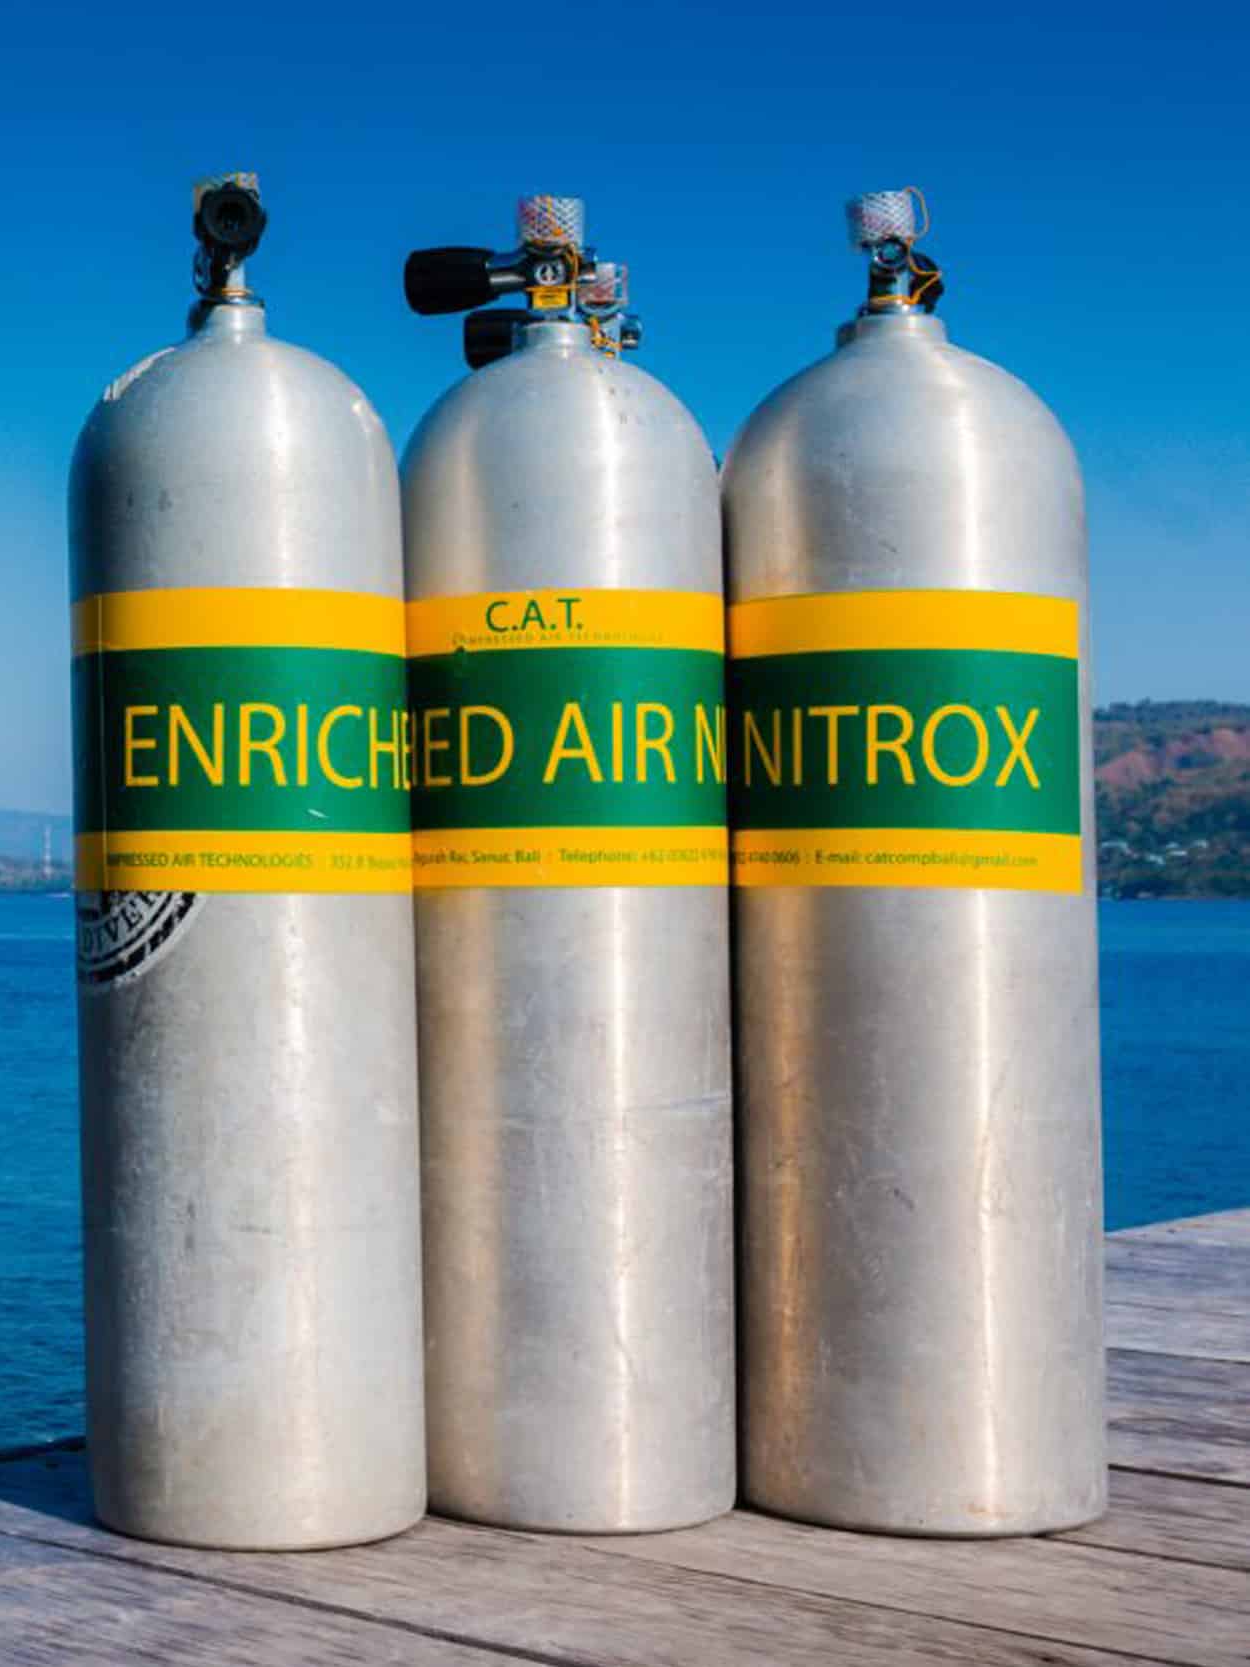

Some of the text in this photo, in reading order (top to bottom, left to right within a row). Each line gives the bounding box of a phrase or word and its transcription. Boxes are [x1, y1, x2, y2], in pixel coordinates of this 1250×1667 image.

[486, 598, 584, 632] C.A.T.
[411, 704, 515, 787] ED
[542, 701, 677, 784] AIR
[743, 704, 1041, 789] NITROX
